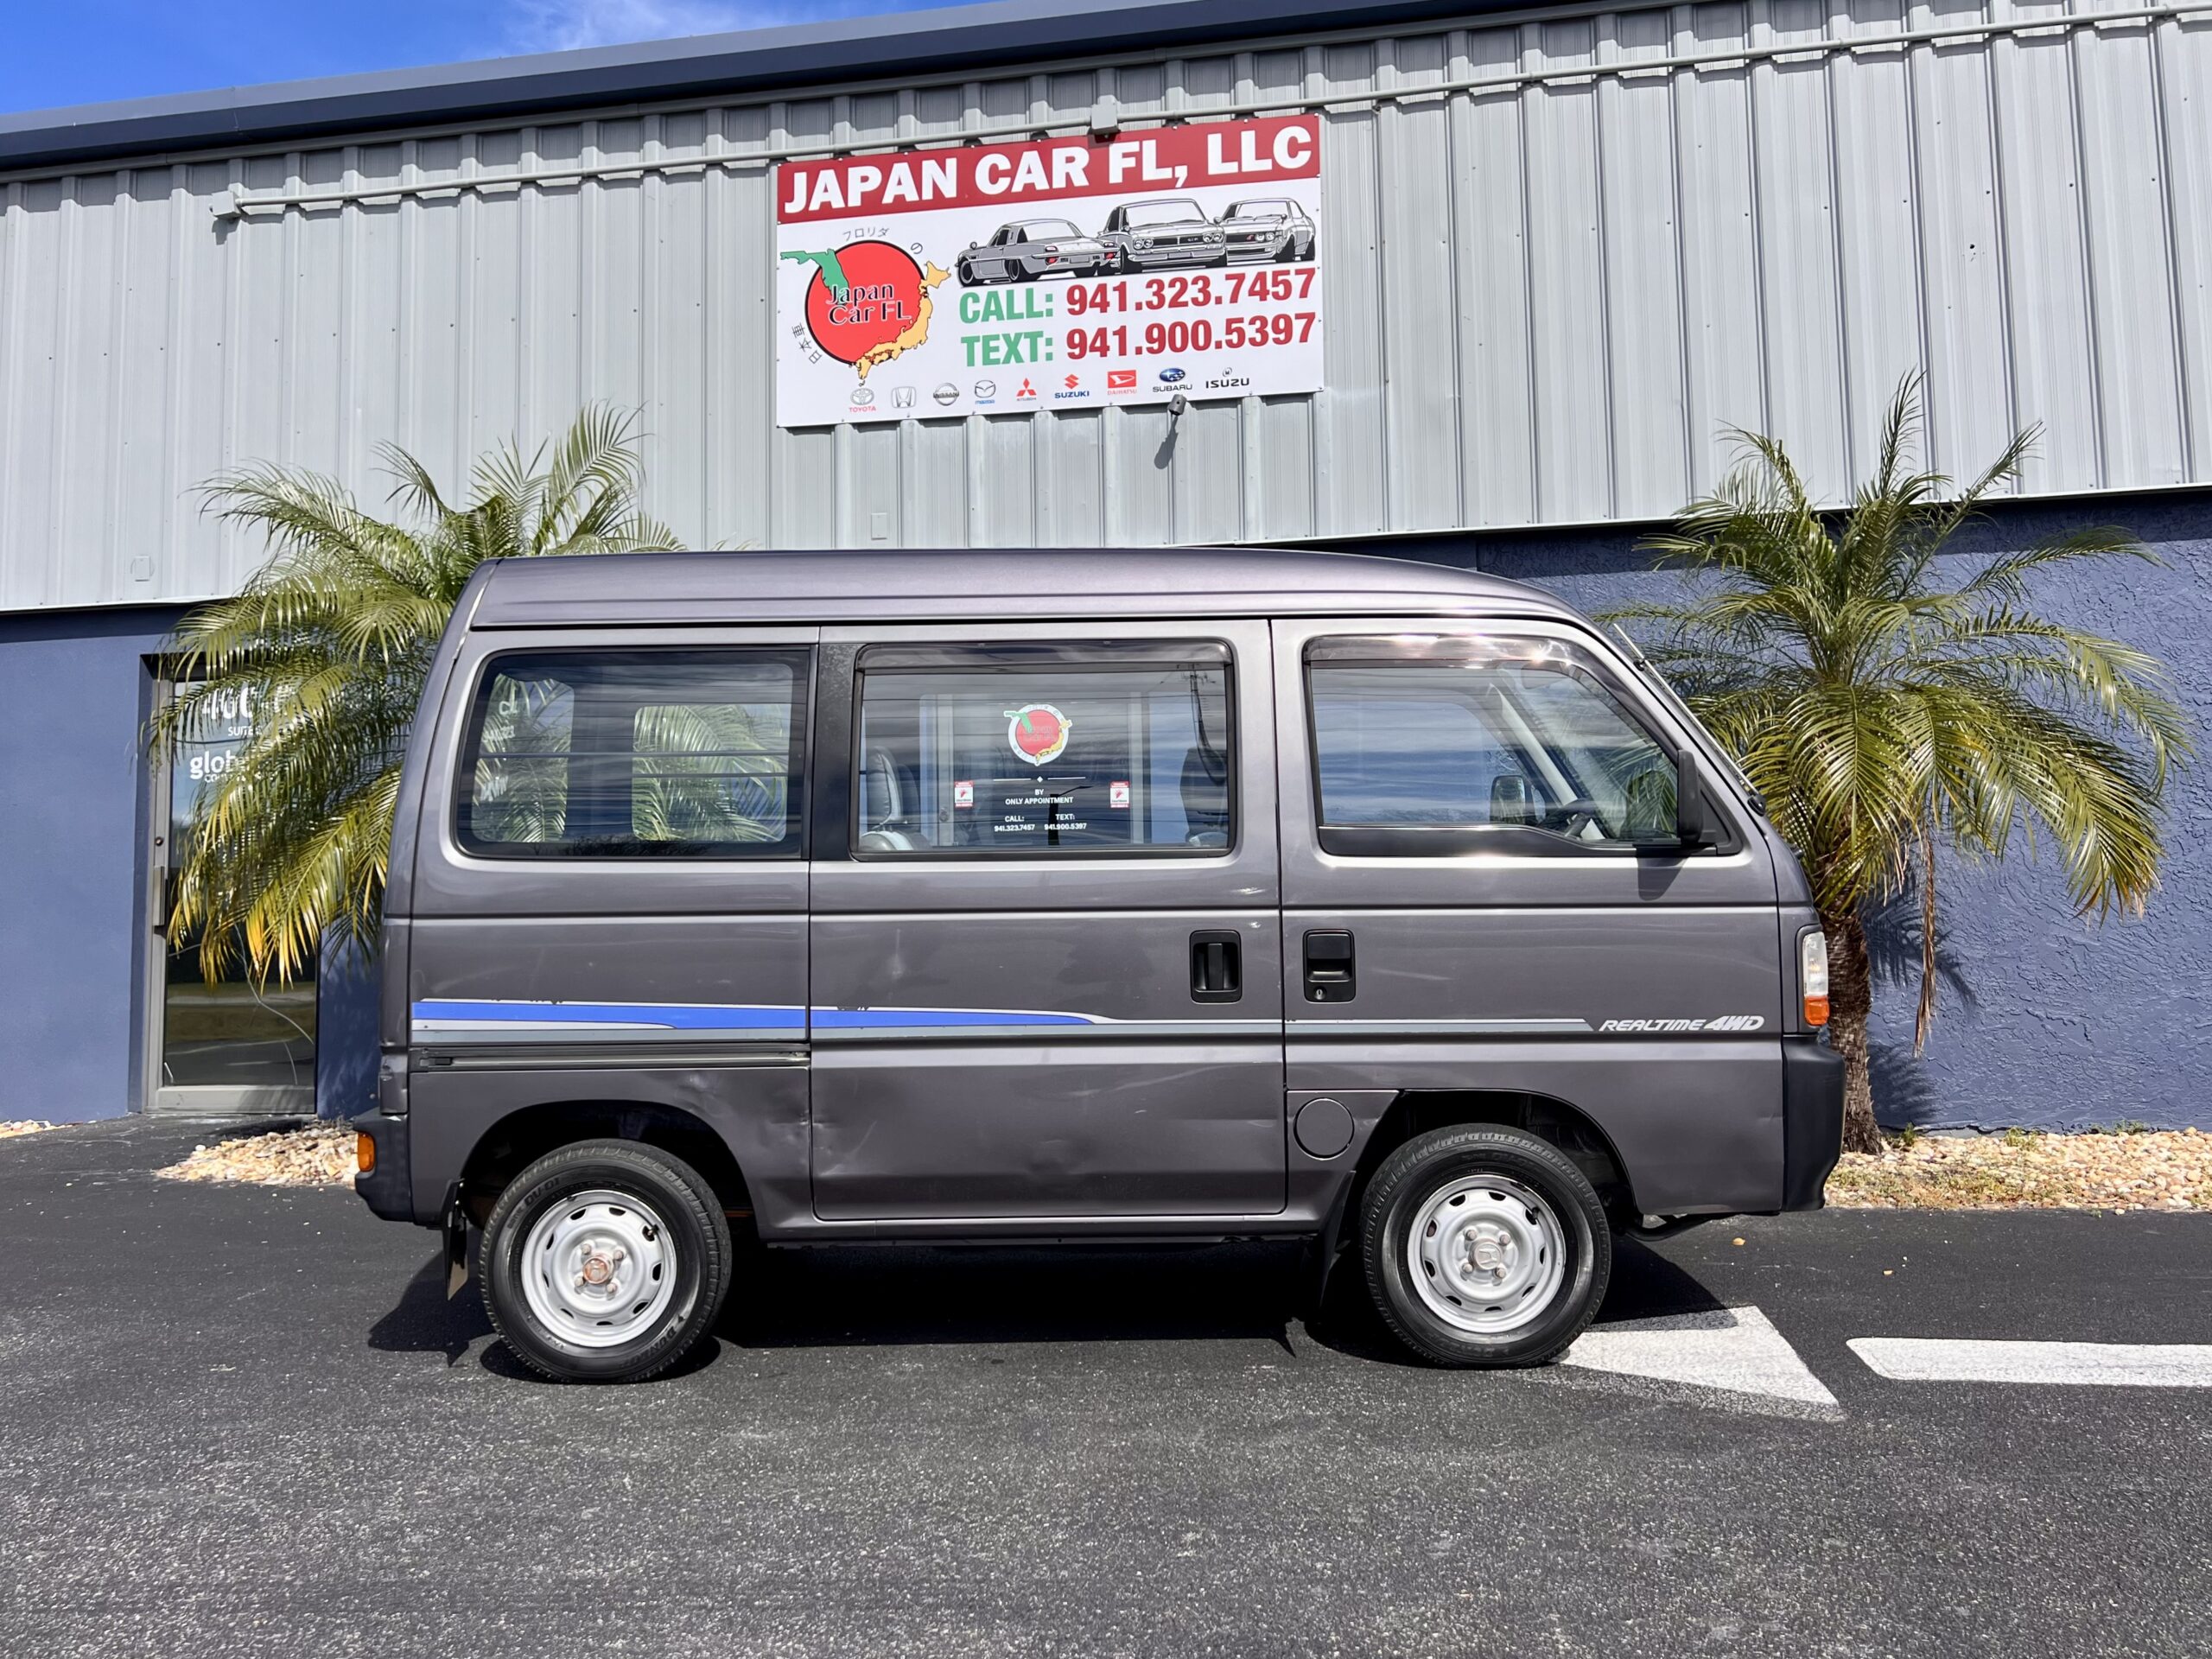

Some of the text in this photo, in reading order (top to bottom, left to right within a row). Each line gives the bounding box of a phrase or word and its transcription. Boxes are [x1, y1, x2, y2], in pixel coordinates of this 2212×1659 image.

[785, 125, 1312, 213] JAPAN CAR FL, LLC
[843, 227, 924, 254] フロリダ の
[827, 284, 893, 307] Japan
[959, 268, 1315, 323] CALL: 941.323.7457
[829, 300, 912, 325] Car FL
[961, 313, 1315, 366] TEXT: 941.900.5397
[1153, 384, 1192, 392] SUBARU
[1205, 378, 1250, 389] ISUZU
[1599, 1015, 1765, 1032] REALTIME 4WD
